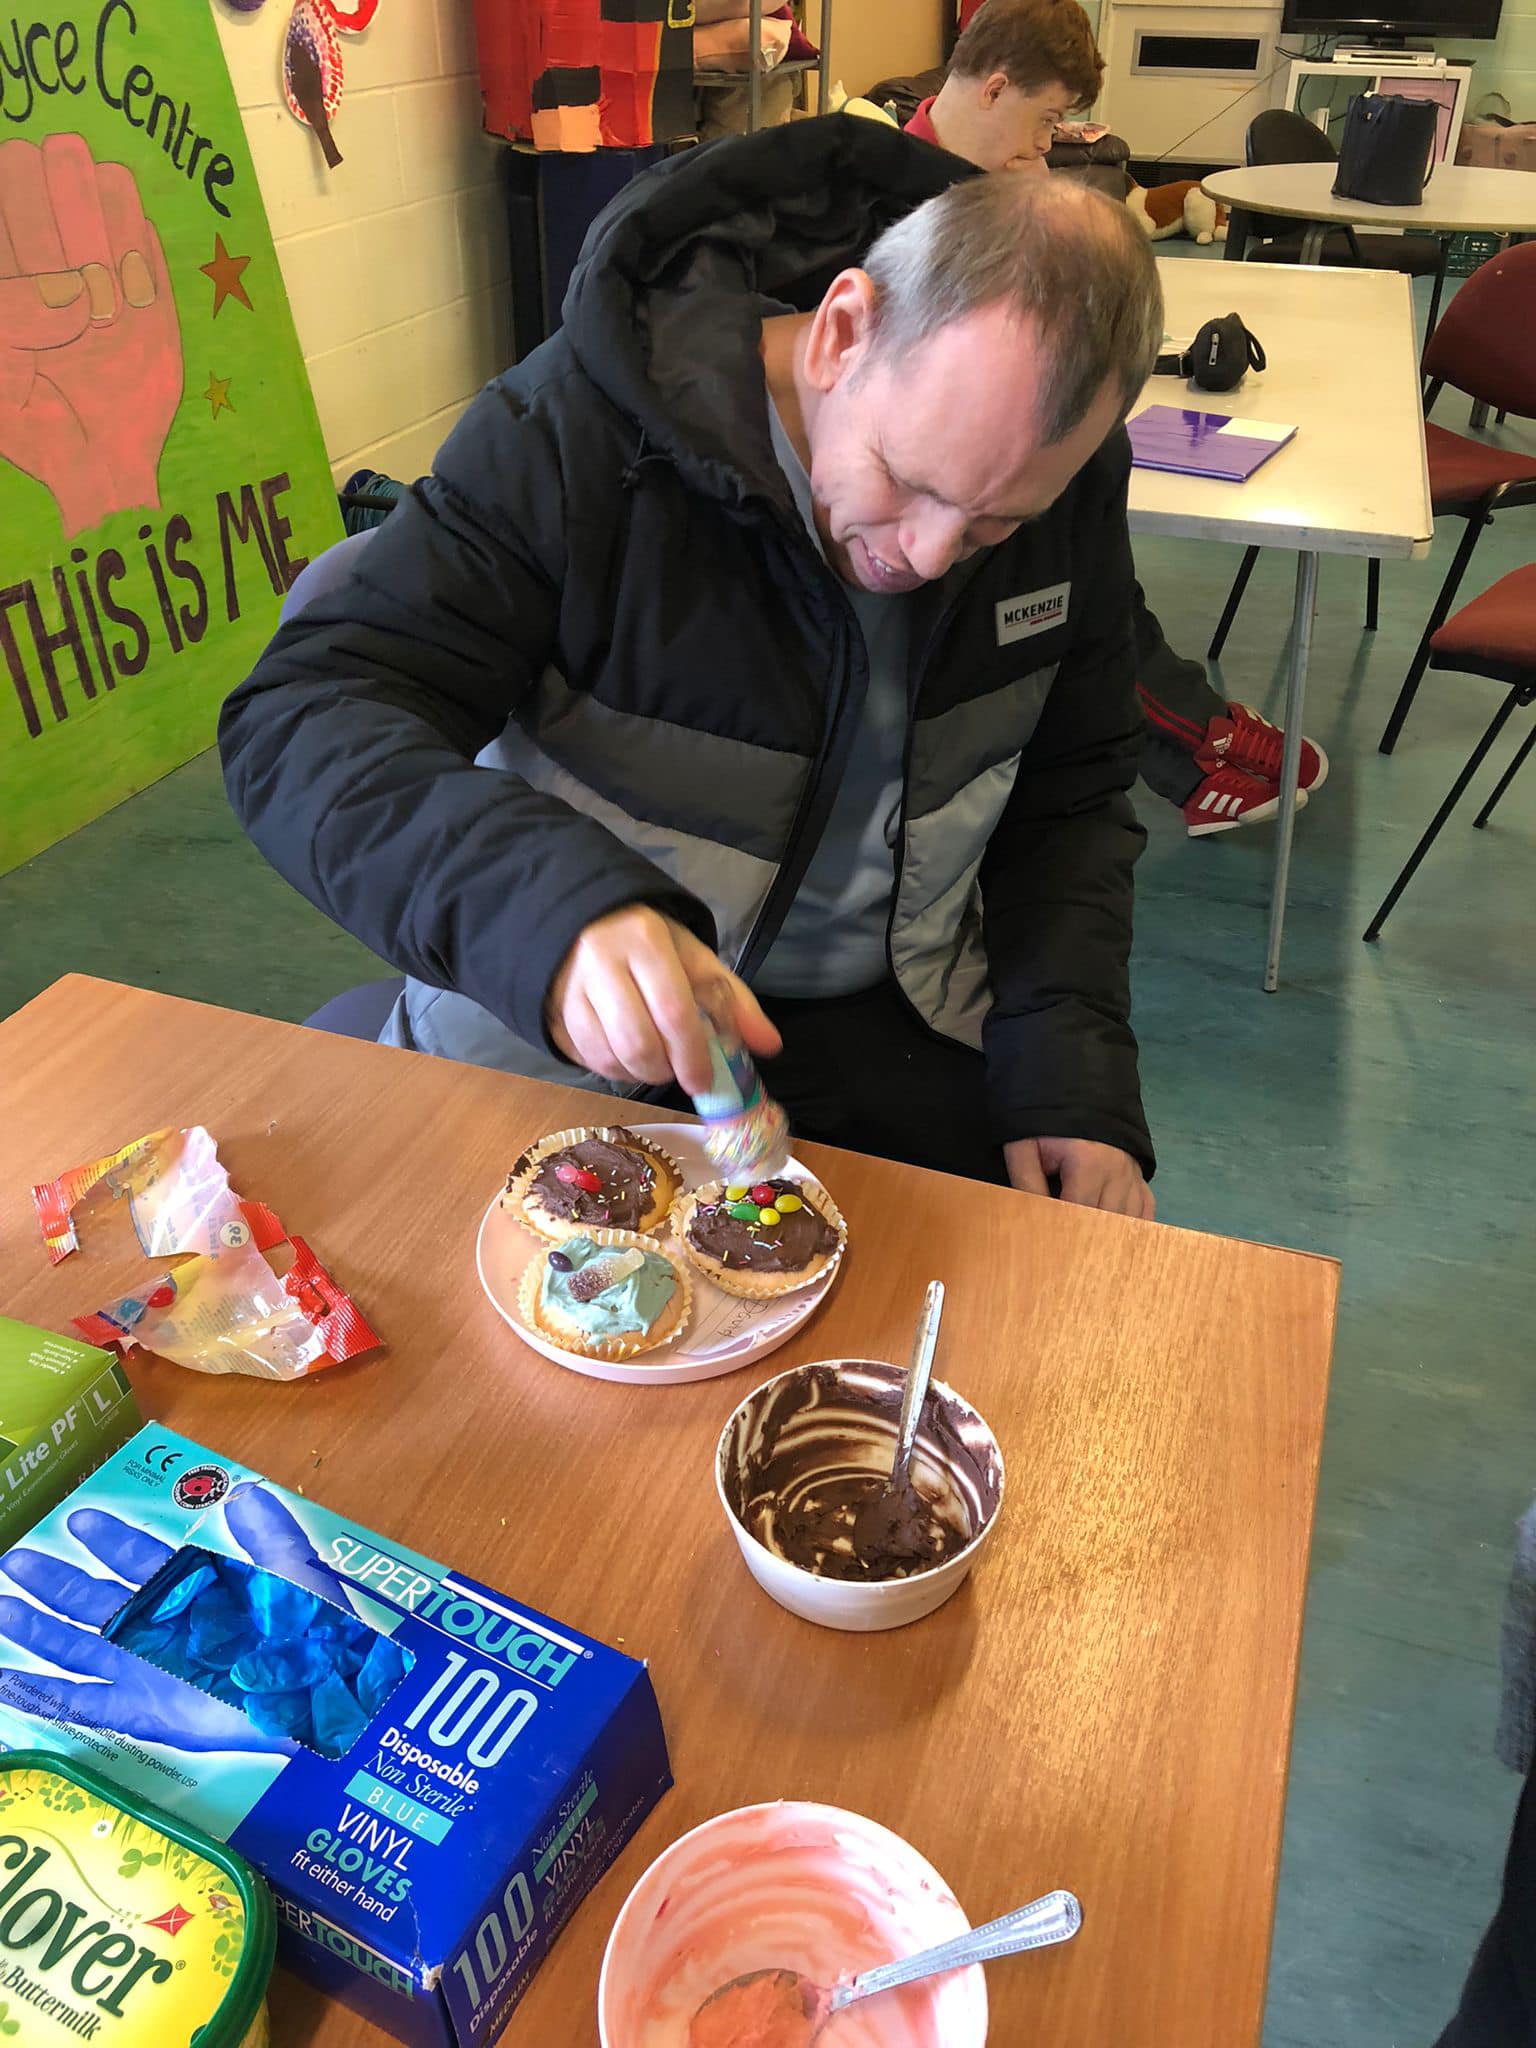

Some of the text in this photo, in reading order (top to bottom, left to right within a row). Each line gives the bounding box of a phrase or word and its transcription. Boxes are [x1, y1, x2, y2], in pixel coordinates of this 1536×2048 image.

[0, 0, 235, 218] yce Centre
[215, 472, 309, 623] ME
[1004, 595, 1064, 625] MCKENZIE
[92, 1390, 112, 1412] L
[5, 1442, 50, 1490] Lite
[51, 1405, 77, 1446] PF
[327, 1537, 578, 1686] SUPERTOUCH
[8, 1673, 54, 1705] Powdered
[51, 1698, 69, 1714] with
[67, 1709, 116, 1742] absorbable
[115, 1736, 148, 1768] dusting
[182, 1775, 198, 1789] USP
[404, 1651, 538, 1768] 100
[364, 1749, 466, 1818] Non Sterile
[379, 1726, 479, 1794] Disposable
[337, 1804, 414, 1871] VINYL
[366, 1786, 429, 1831] BLUE
[290, 1849, 398, 1922] fit either hand
[306, 1828, 413, 1902] GLOVES
[545, 1816, 596, 1887] VINYL
[272, 1892, 414, 2000] PERTOUCH
[453, 1871, 535, 2010] 100
[3, 1965, 101, 2041] Buttermilk
[469, 1928, 538, 2033] Disposable
